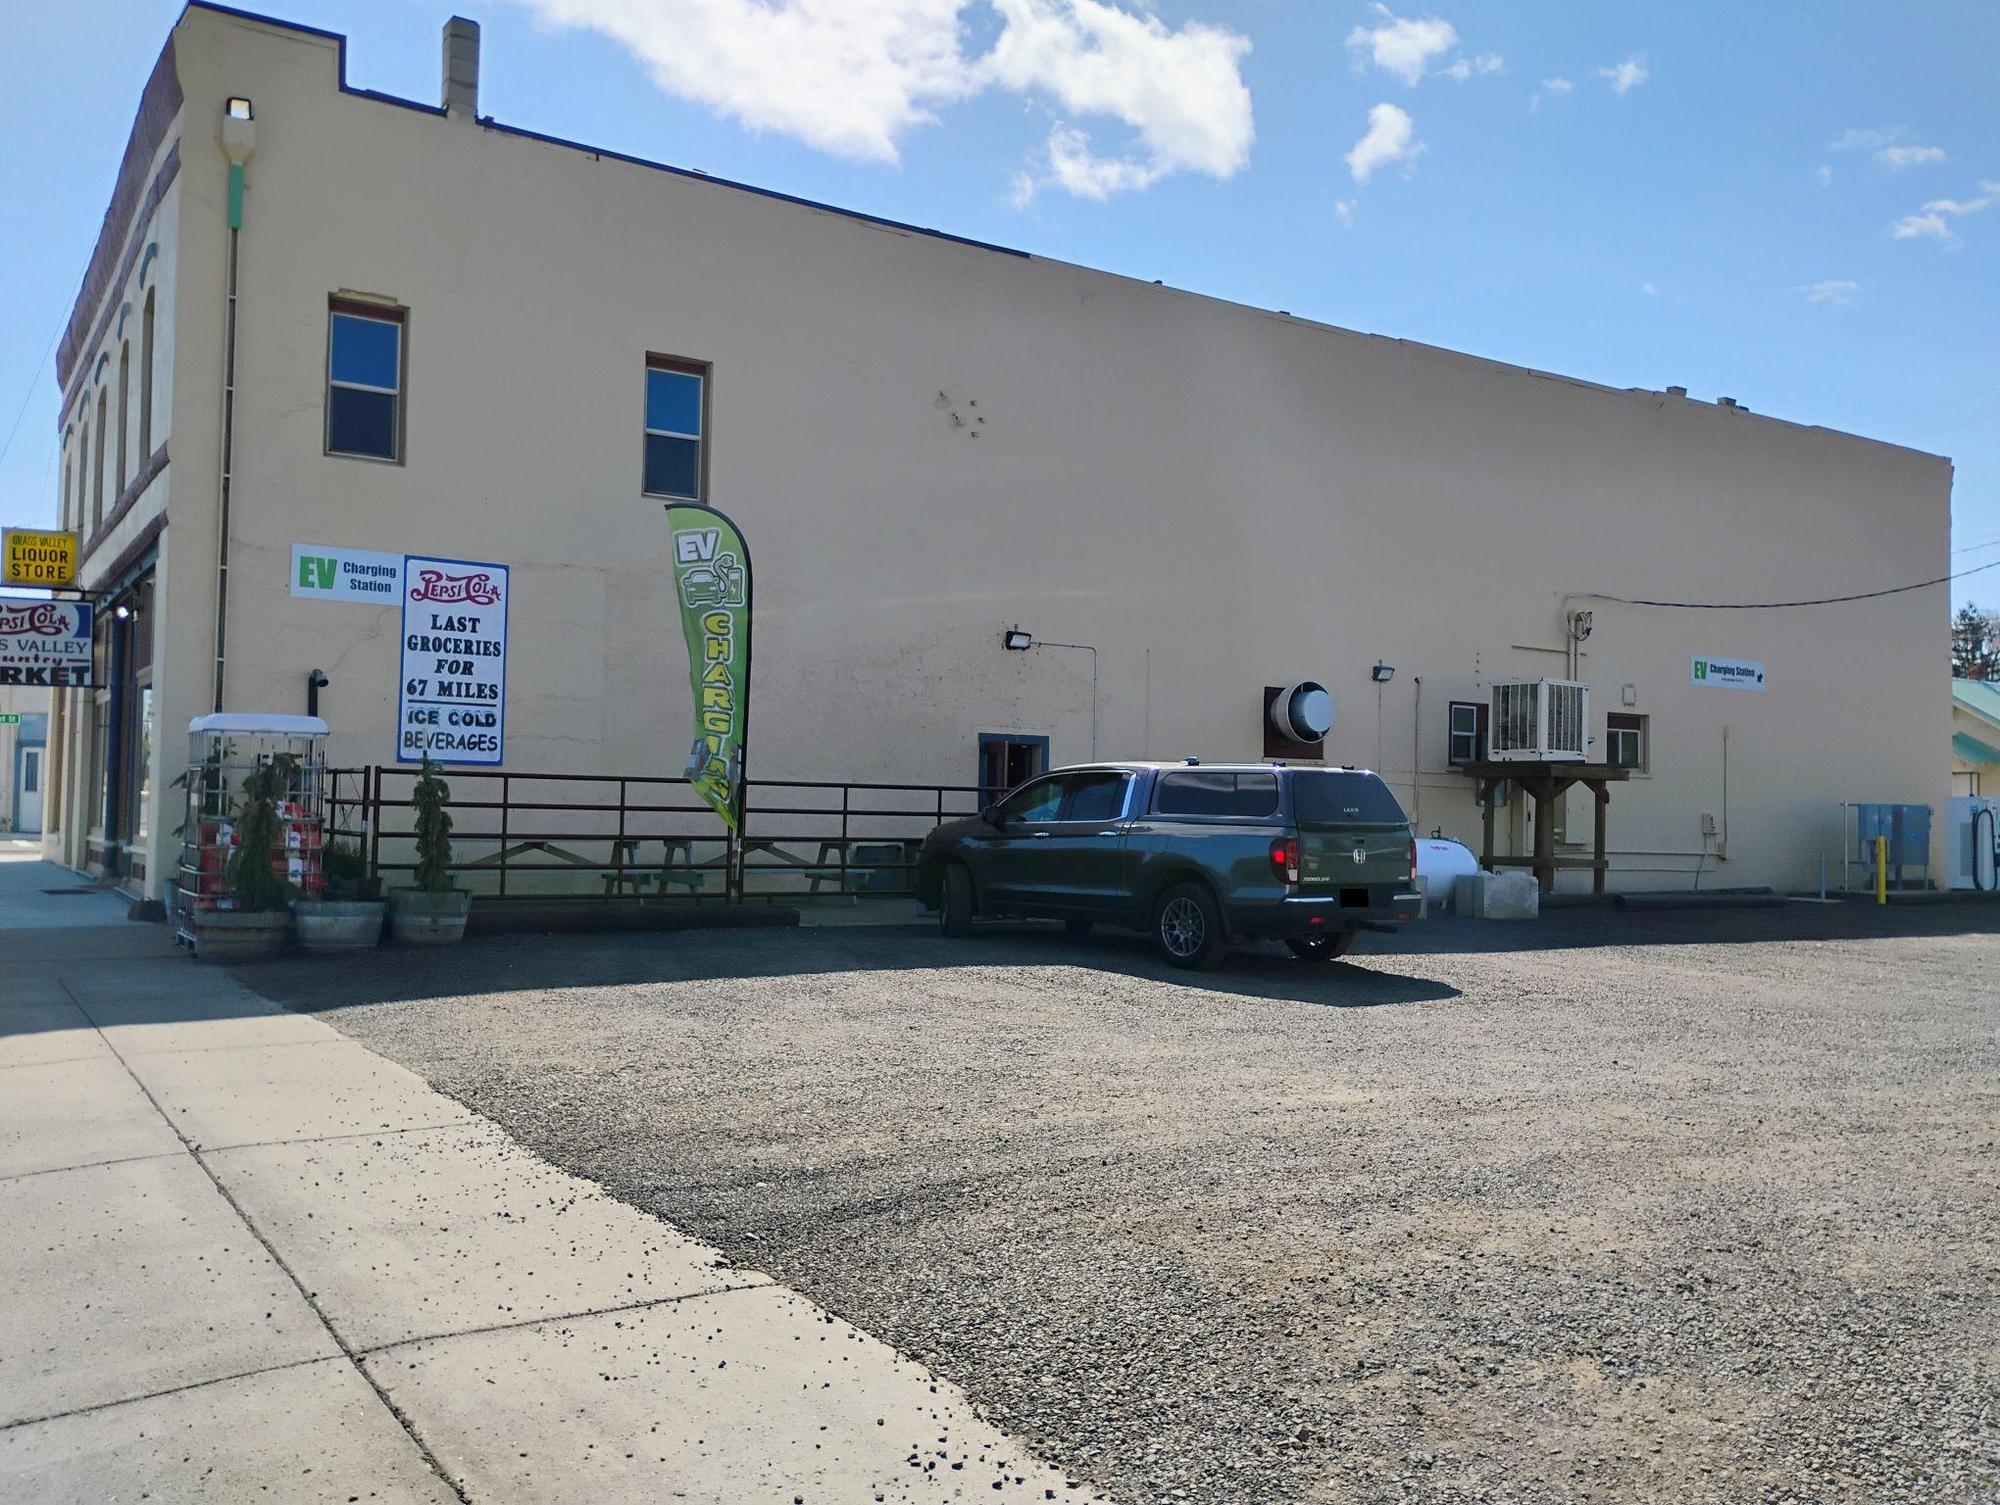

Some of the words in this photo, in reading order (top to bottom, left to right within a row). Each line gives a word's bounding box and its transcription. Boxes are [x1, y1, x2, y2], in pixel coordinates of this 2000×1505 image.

[12, 535, 37, 545] GRASS
[40, 537, 67, 547] VALLEY
[676, 531, 718, 562] EV
[12, 547, 68, 563] LIQUOR
[12, 563, 67, 579] STORE
[299, 555, 338, 590] EV
[343, 561, 397, 579] Charging
[350, 578, 392, 593] Station
[430, 614, 481, 633] LAST
[17, 639, 88, 654] VALLEY
[407, 634, 502, 657] GROCERIES
[0, 665, 90, 686] RKET
[434, 659, 475, 676] FOR
[1694, 661, 1707, 680] EV
[1710, 663, 1735, 677] Charging
[1736, 666, 1755, 678] Station
[406, 678, 428, 697] 67
[437, 681, 499, 700] MILES
[407, 708, 439, 725] ICE
[448, 710, 497, 728] COLD
[404, 731, 498, 751] BEVERAGES
